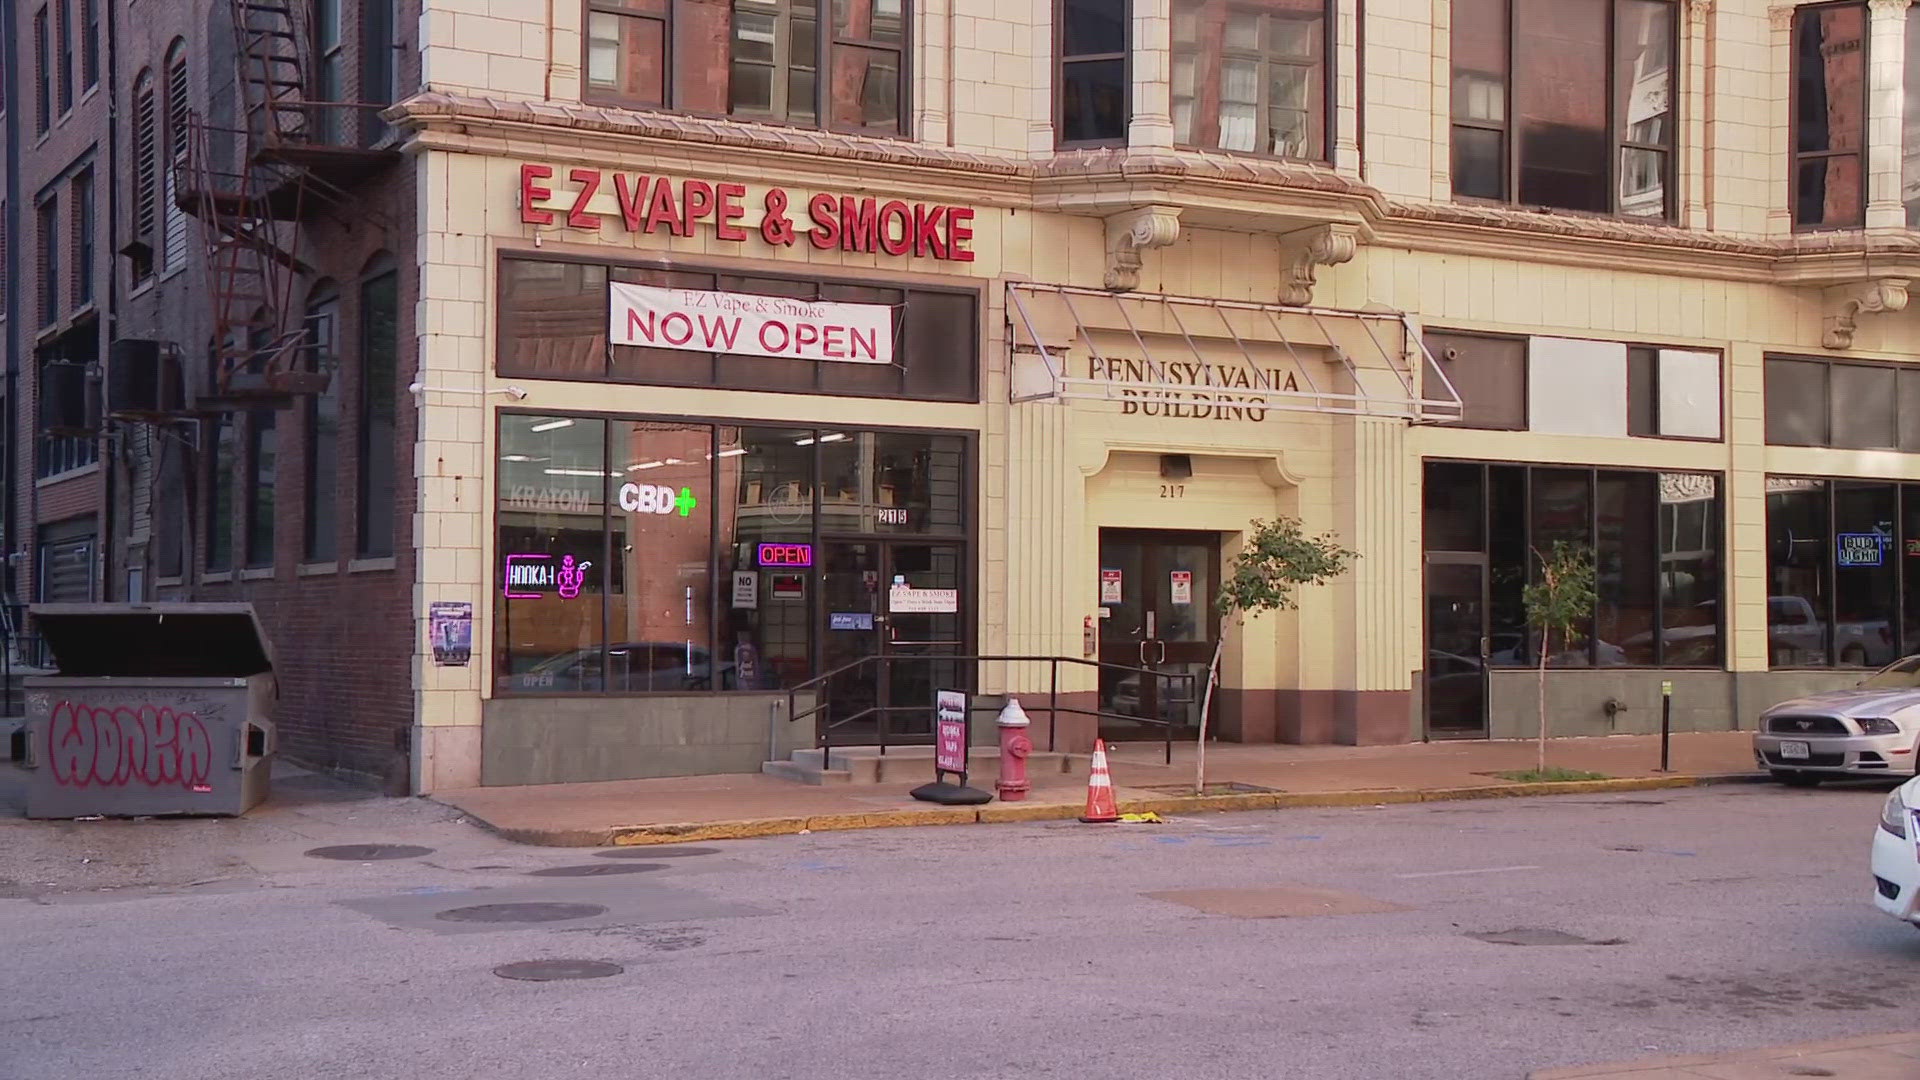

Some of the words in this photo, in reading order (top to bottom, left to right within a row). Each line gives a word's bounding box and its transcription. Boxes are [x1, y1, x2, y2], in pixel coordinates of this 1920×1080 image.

[613, 173, 748, 242] VAPE
[761, 187, 796, 247] &
[808, 193, 975, 262] SMOKE
[684, 292, 708, 308] EZ
[712, 293, 751, 316] Vape
[755, 296, 768, 313] &
[773, 299, 825, 319] Smoke
[627, 307, 742, 350] NOW
[758, 320, 876, 360] OPEN
[1088, 356, 1299, 392] PENNSYLVANIA
[1121, 389, 1268, 422] BUILDING
[509, 484, 590, 512] KRATOM
[1160, 485, 1184, 498] 217
[878, 509, 907, 524] 215
[1844, 536, 1873, 549] BUD
[762, 546, 808, 563] OPEN
[1840, 549, 1878, 562] LIGHT
[738, 576, 752, 586] NO
[523, 677, 553, 687] OPEN
